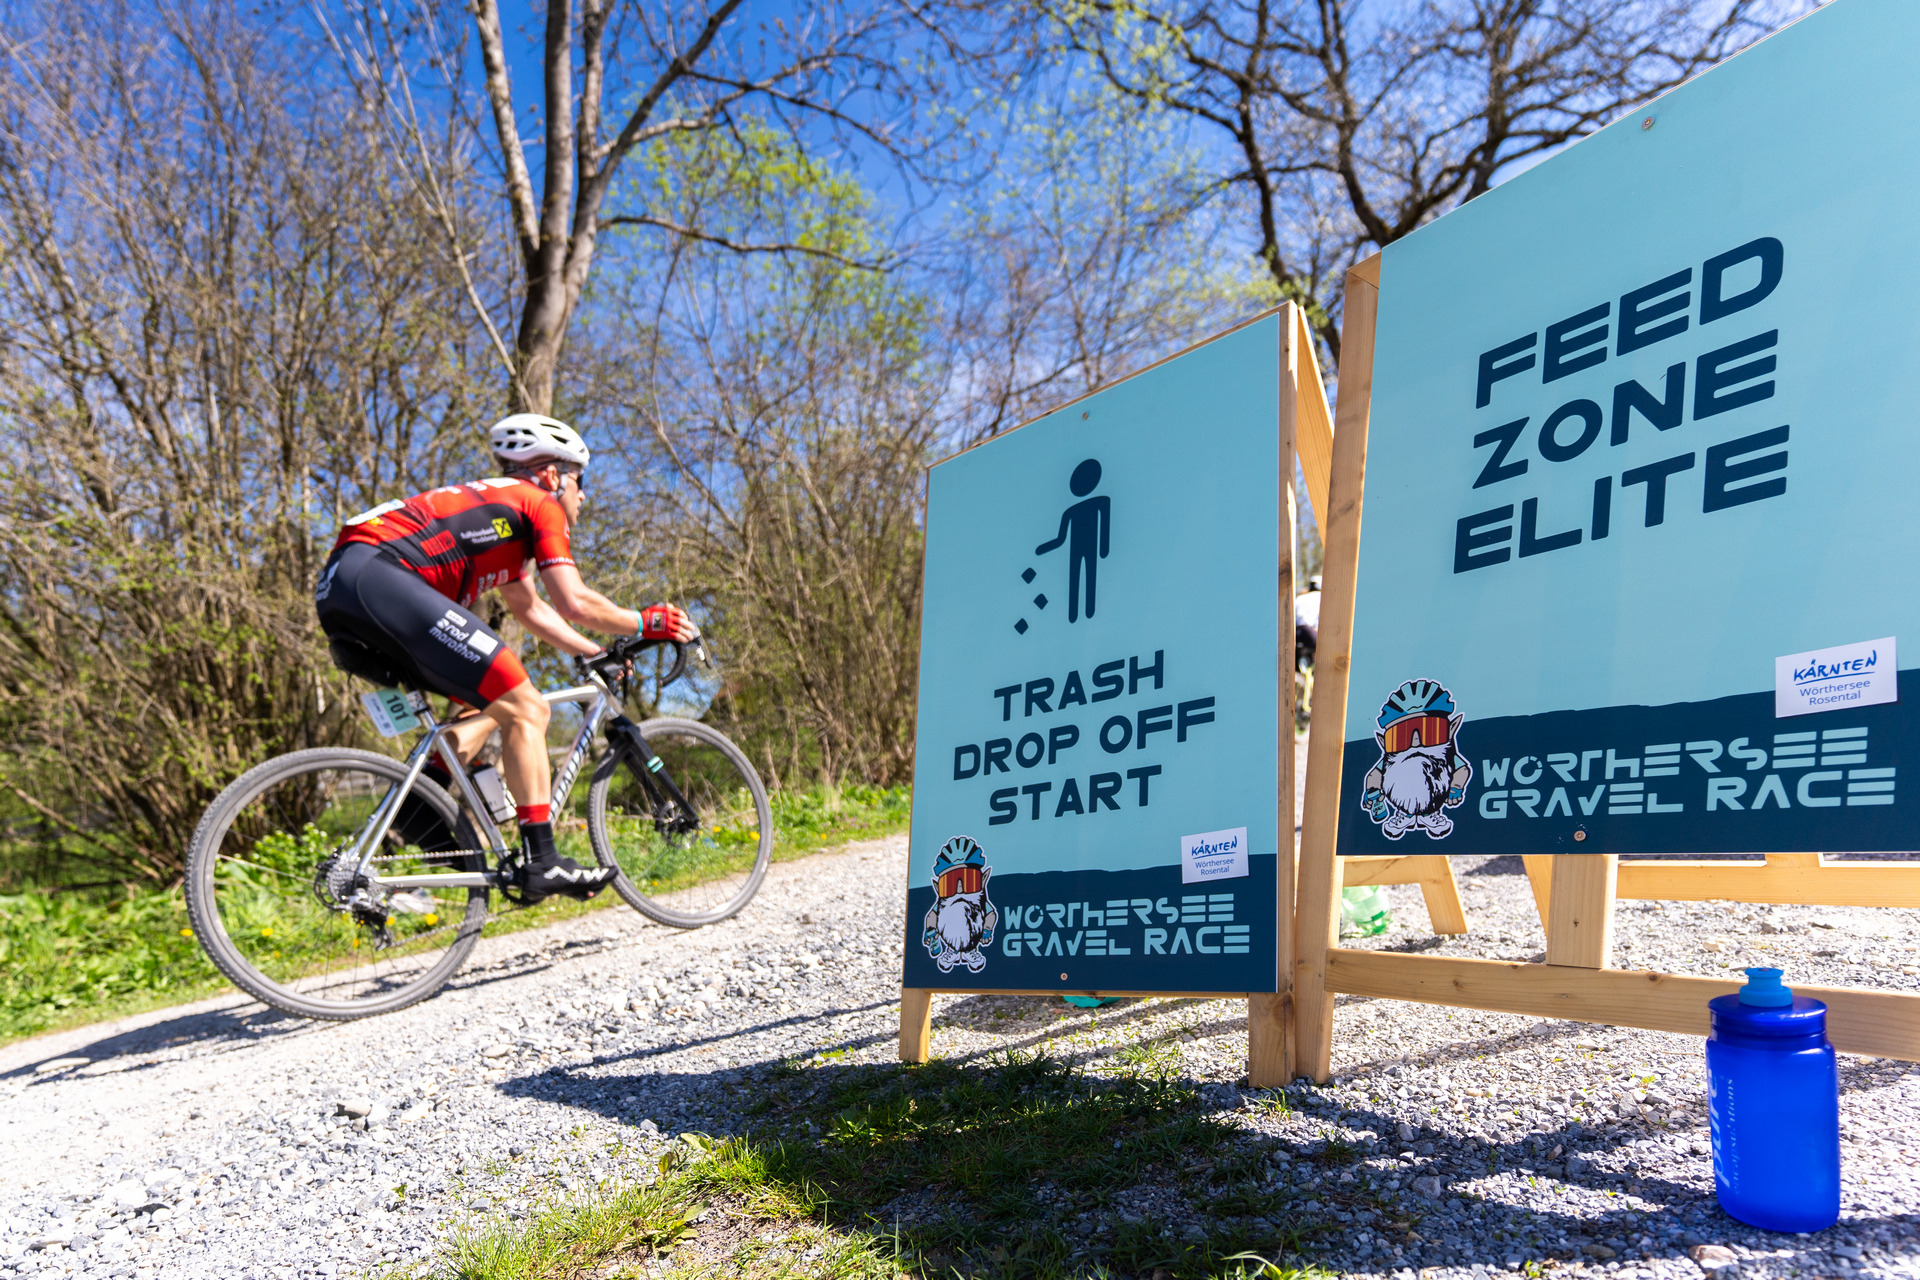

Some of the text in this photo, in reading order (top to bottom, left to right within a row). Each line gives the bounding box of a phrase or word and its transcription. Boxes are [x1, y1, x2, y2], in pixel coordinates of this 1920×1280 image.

[1475, 236, 1784, 409] FEED
[1472, 328, 1779, 489] ZONE
[1453, 424, 1790, 574] ELITE
[428, 626, 482, 663] marathon
[386, 694, 409, 721] 101
[993, 649, 1164, 722] TRASH
[1799, 680, 1871, 697] Wörthersee
[1809, 690, 1861, 706] Rosental
[953, 695, 1216, 781] DROP OFF
[988, 764, 1162, 826] START
[1478, 767, 1896, 820] GRAVEL RACE
[1195, 858, 1235, 869] Wörthersee
[1200, 866, 1230, 876] Rosental
[1002, 925, 1250, 957] GRAVEL RACE
